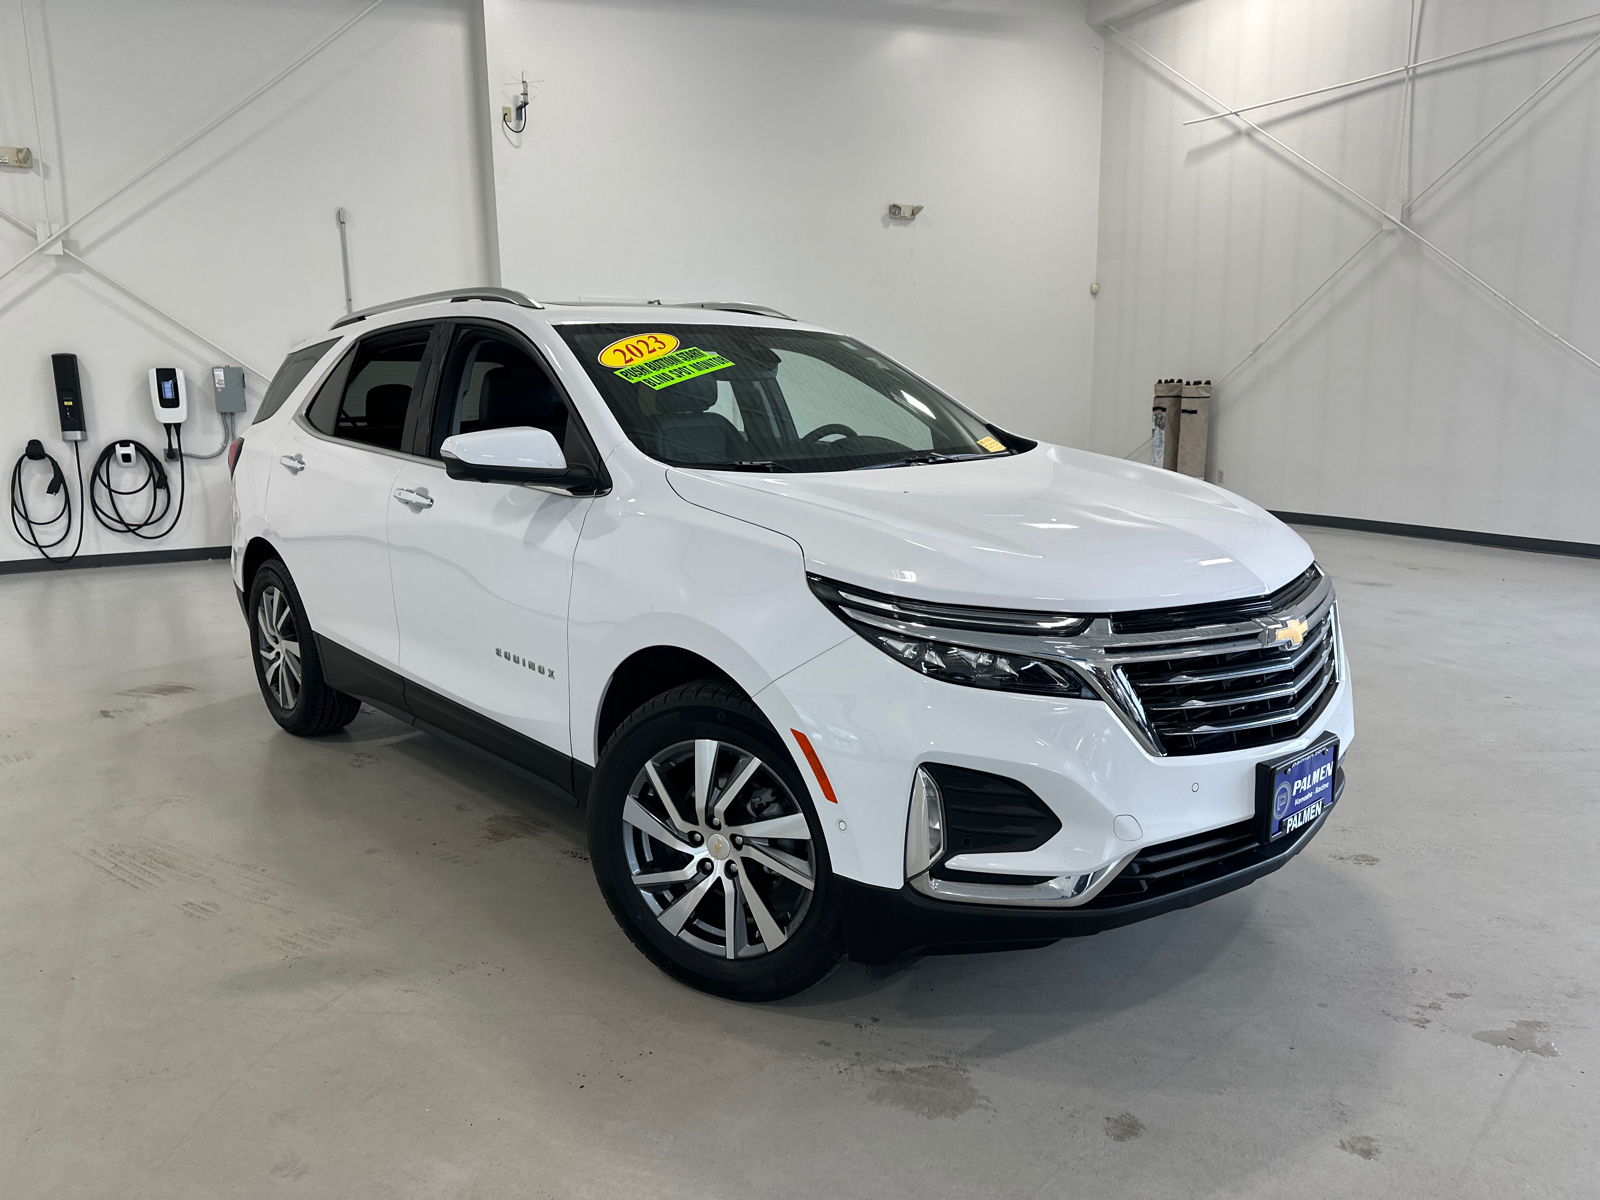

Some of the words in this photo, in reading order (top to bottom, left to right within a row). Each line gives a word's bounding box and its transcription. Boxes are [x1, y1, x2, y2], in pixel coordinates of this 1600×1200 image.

[613, 335, 666, 364] 2023
[619, 364, 649, 381] PUSH
[645, 354, 682, 372] BUTTON
[676, 348, 708, 361] START
[642, 369, 675, 387] BLIND
[668, 365, 695, 379] SPOT
[689, 355, 732, 372] MONITOR
[495, 647, 555, 680] EQUINOX
[1292, 761, 1334, 796] PALMEN
[1315, 782, 1330, 794] Racine
[1286, 800, 1323, 834] PALMEN
